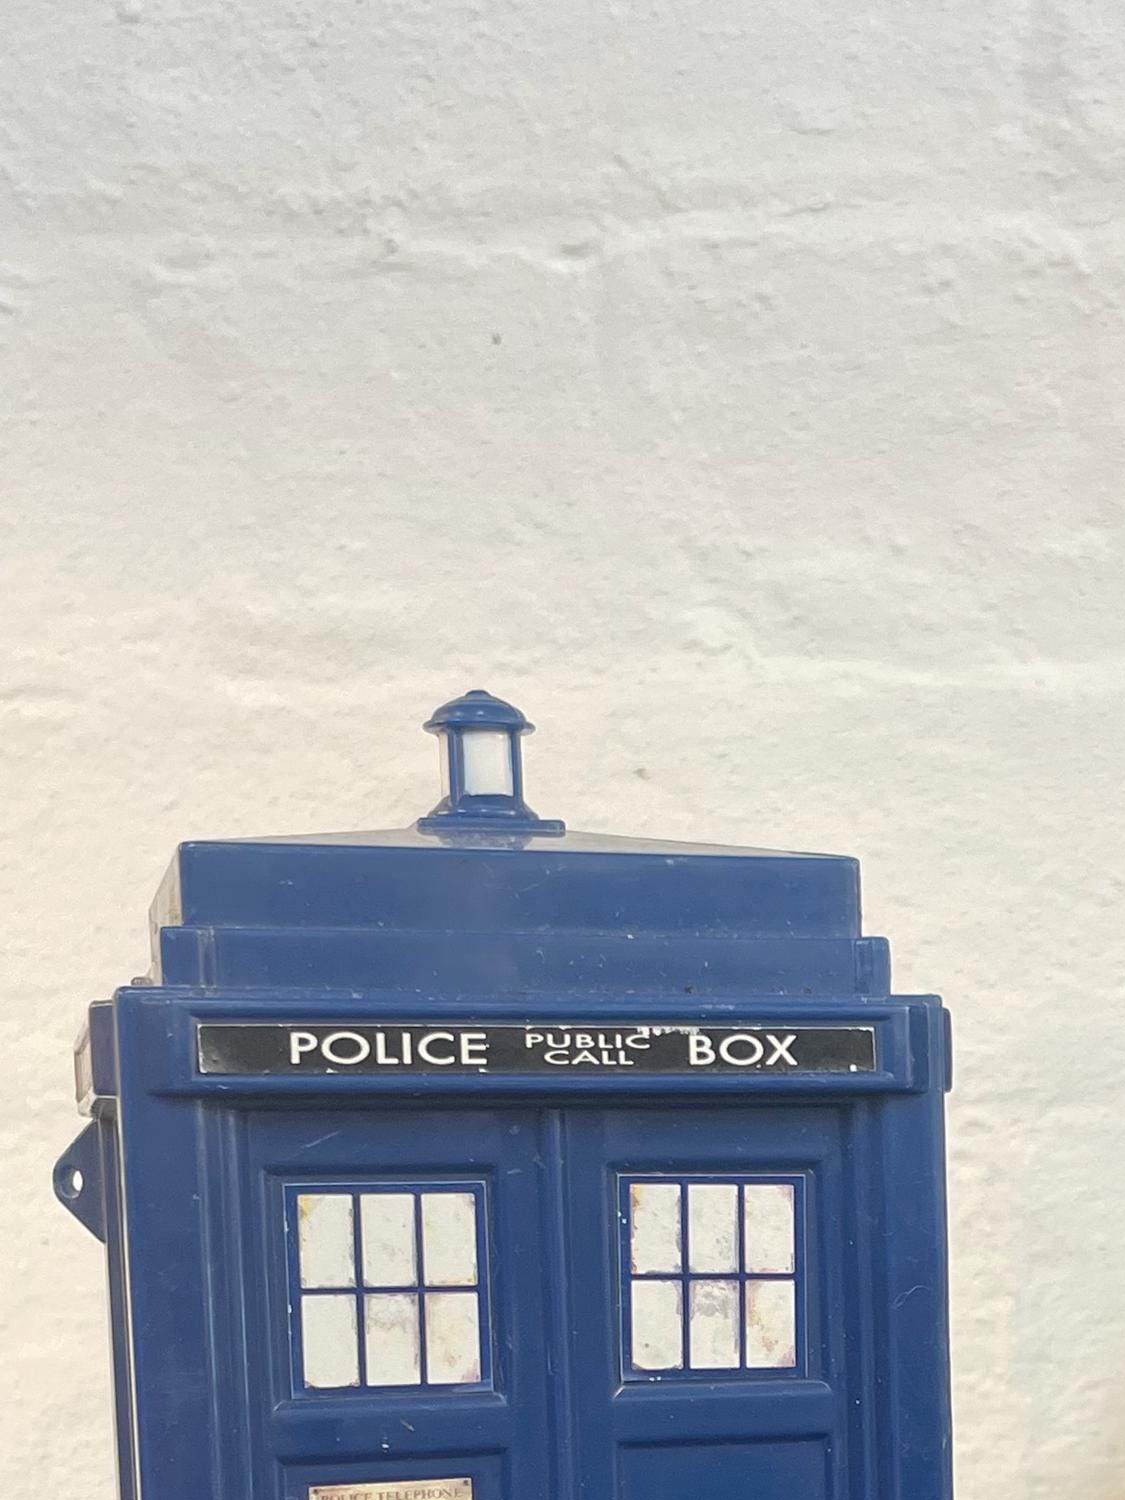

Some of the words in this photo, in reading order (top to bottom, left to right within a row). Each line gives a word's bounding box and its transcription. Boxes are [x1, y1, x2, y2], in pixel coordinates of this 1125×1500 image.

[289, 1031, 488, 1066] POLICE
[525, 1033, 652, 1050] PUBLIC
[688, 1034, 798, 1067] BOX
[544, 1050, 634, 1066] CALL
